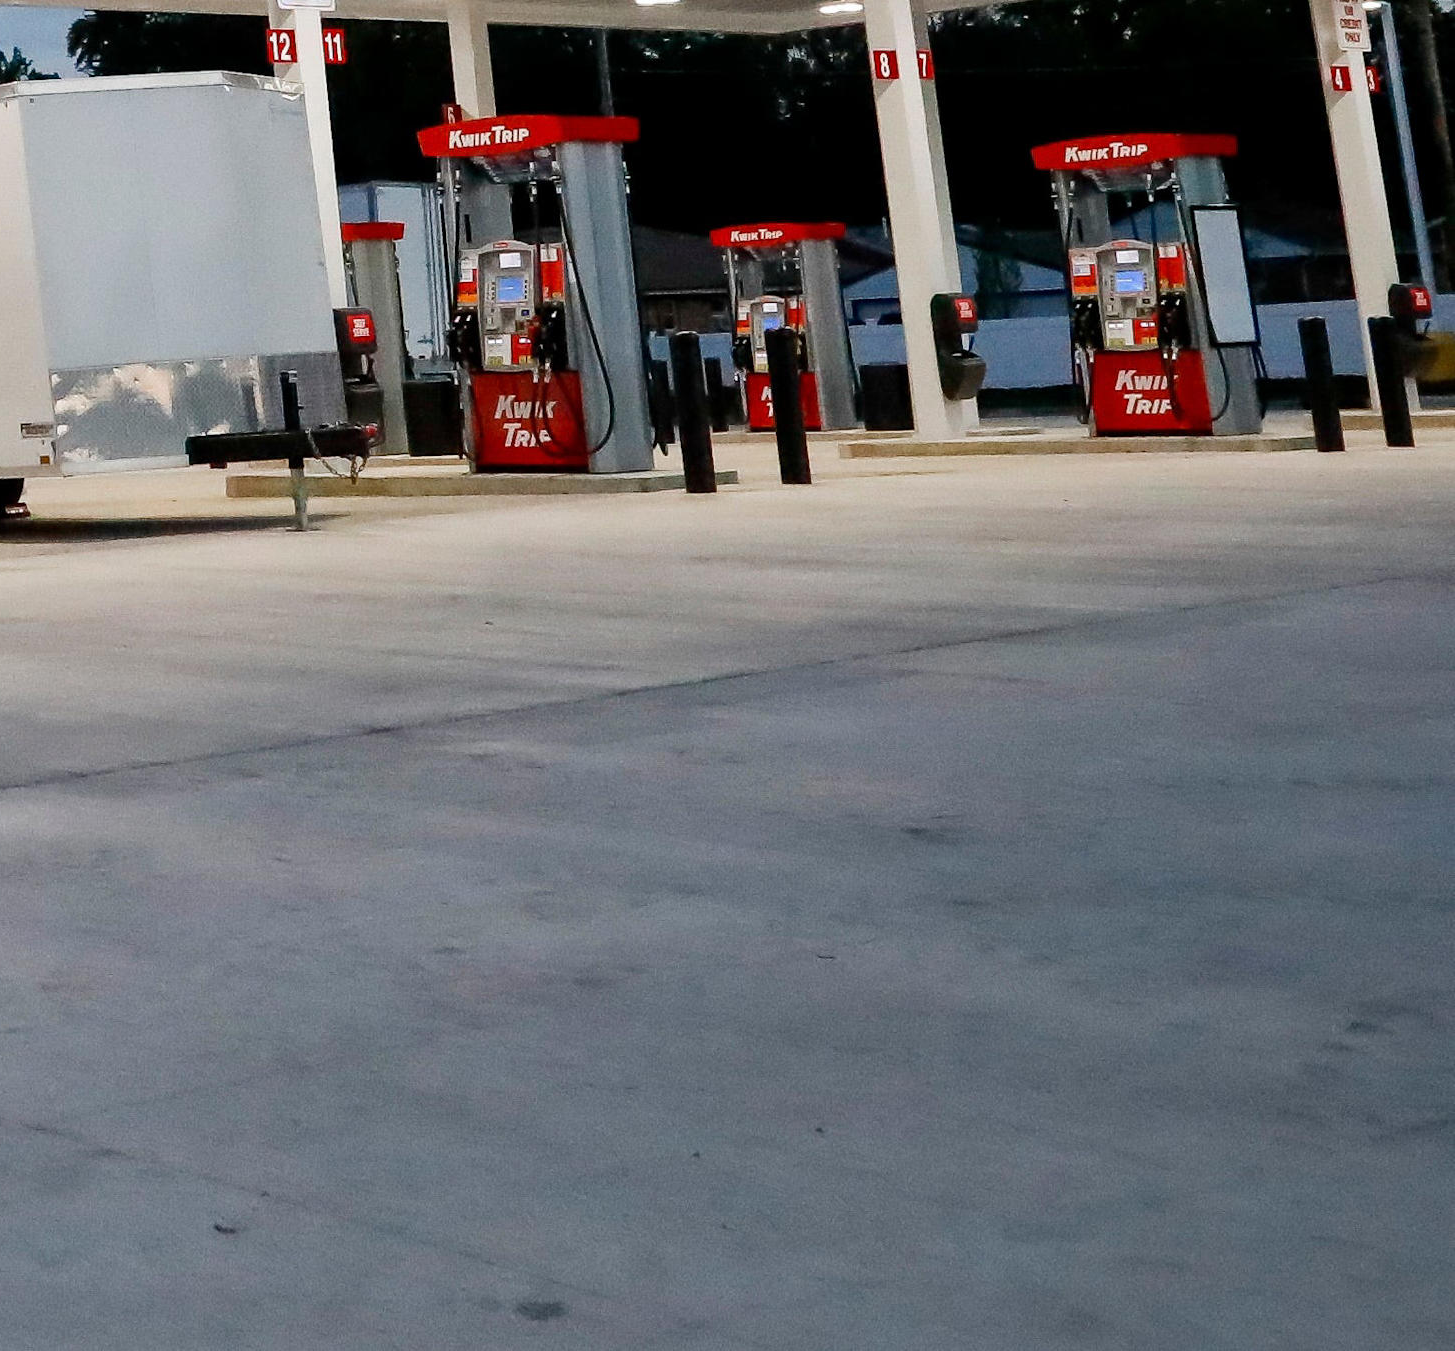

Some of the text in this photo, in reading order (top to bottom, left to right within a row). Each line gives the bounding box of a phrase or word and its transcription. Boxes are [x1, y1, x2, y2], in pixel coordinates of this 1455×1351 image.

[269, 32, 292, 61] 12
[325, 32, 342, 62] 11
[880, 52, 890, 78] 8
[919, 53, 927, 77] 7
[1335, 68, 1343, 90] 4
[449, 125, 530, 149] KWIK TRIP
[1064, 142, 1148, 163] KWIK TRIP
